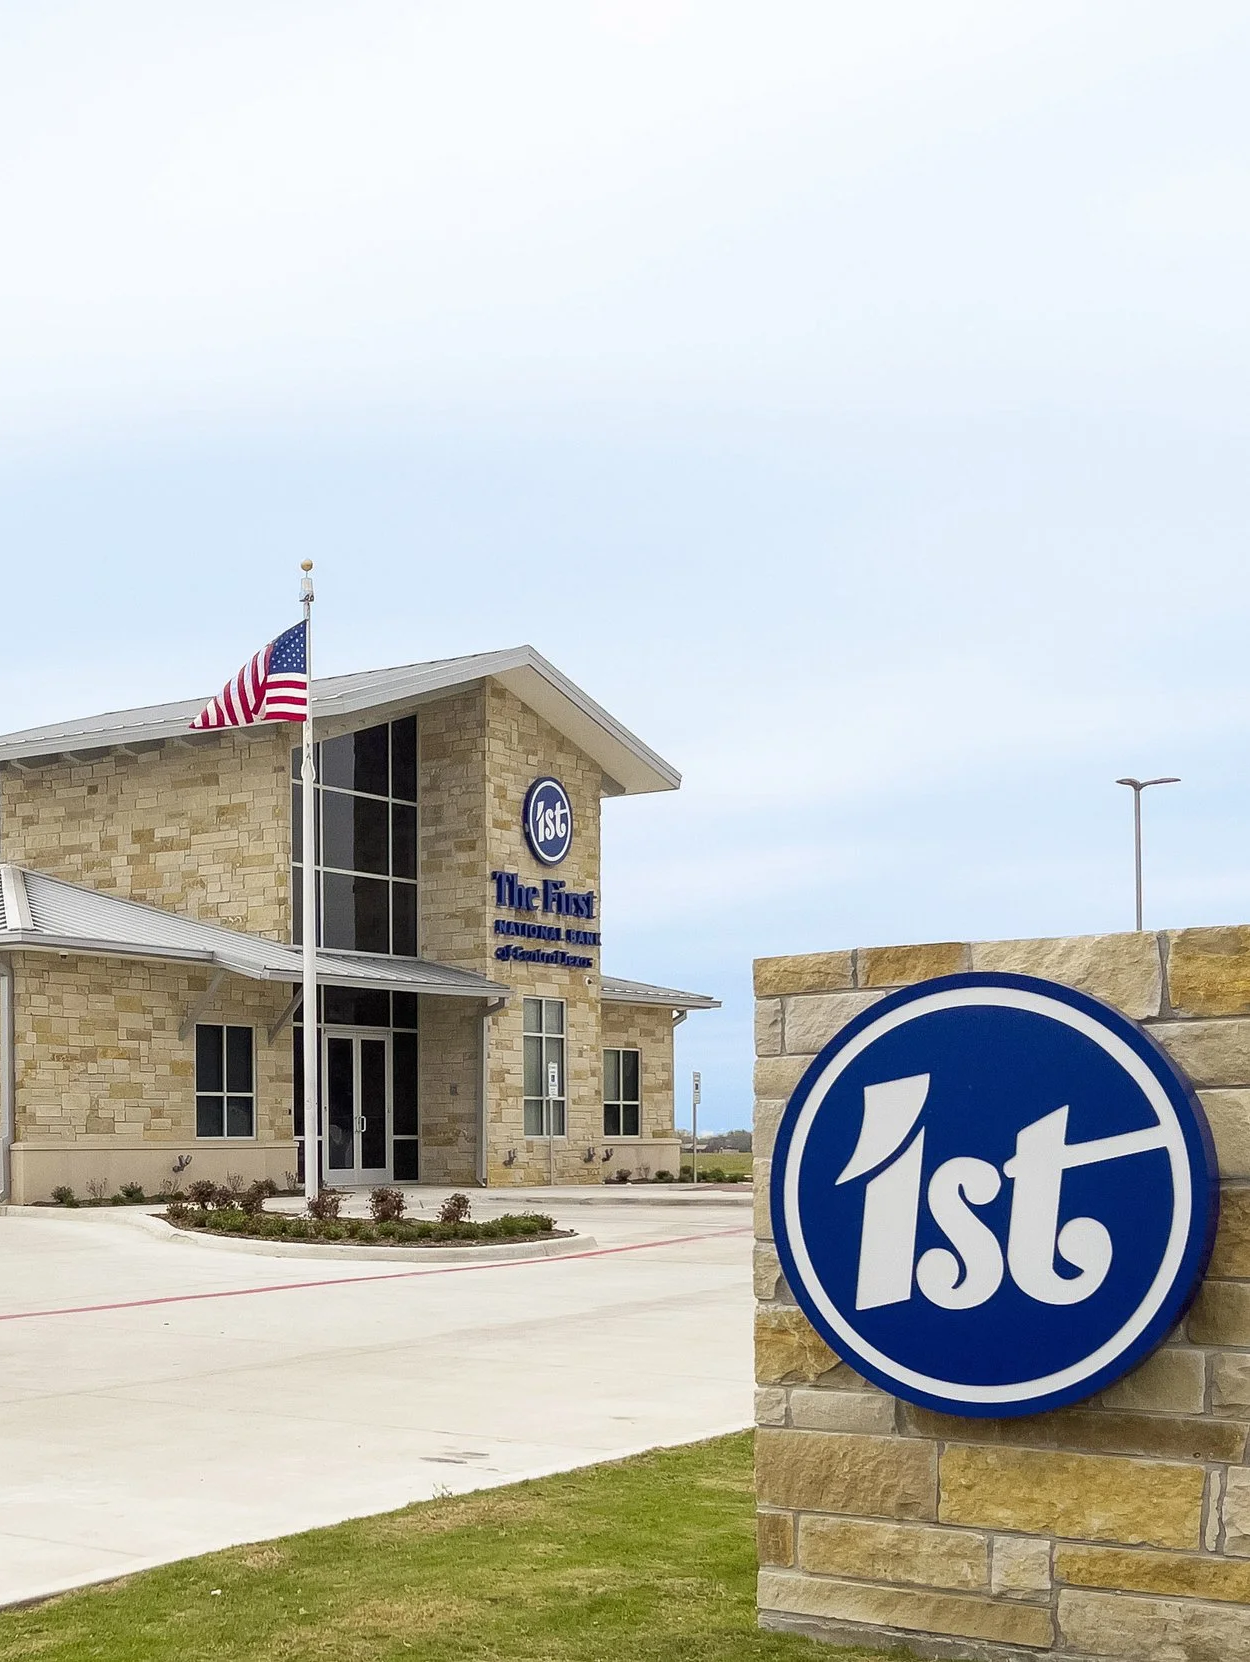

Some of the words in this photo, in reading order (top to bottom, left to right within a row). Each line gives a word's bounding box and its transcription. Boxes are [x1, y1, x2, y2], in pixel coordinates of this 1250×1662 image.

[536, 801, 568, 842] 1st
[491, 871, 540, 911] The
[542, 879, 597, 919] First
[494, 919, 565, 941] NATIONAL
[835, 1073, 1166, 1311] 1st
